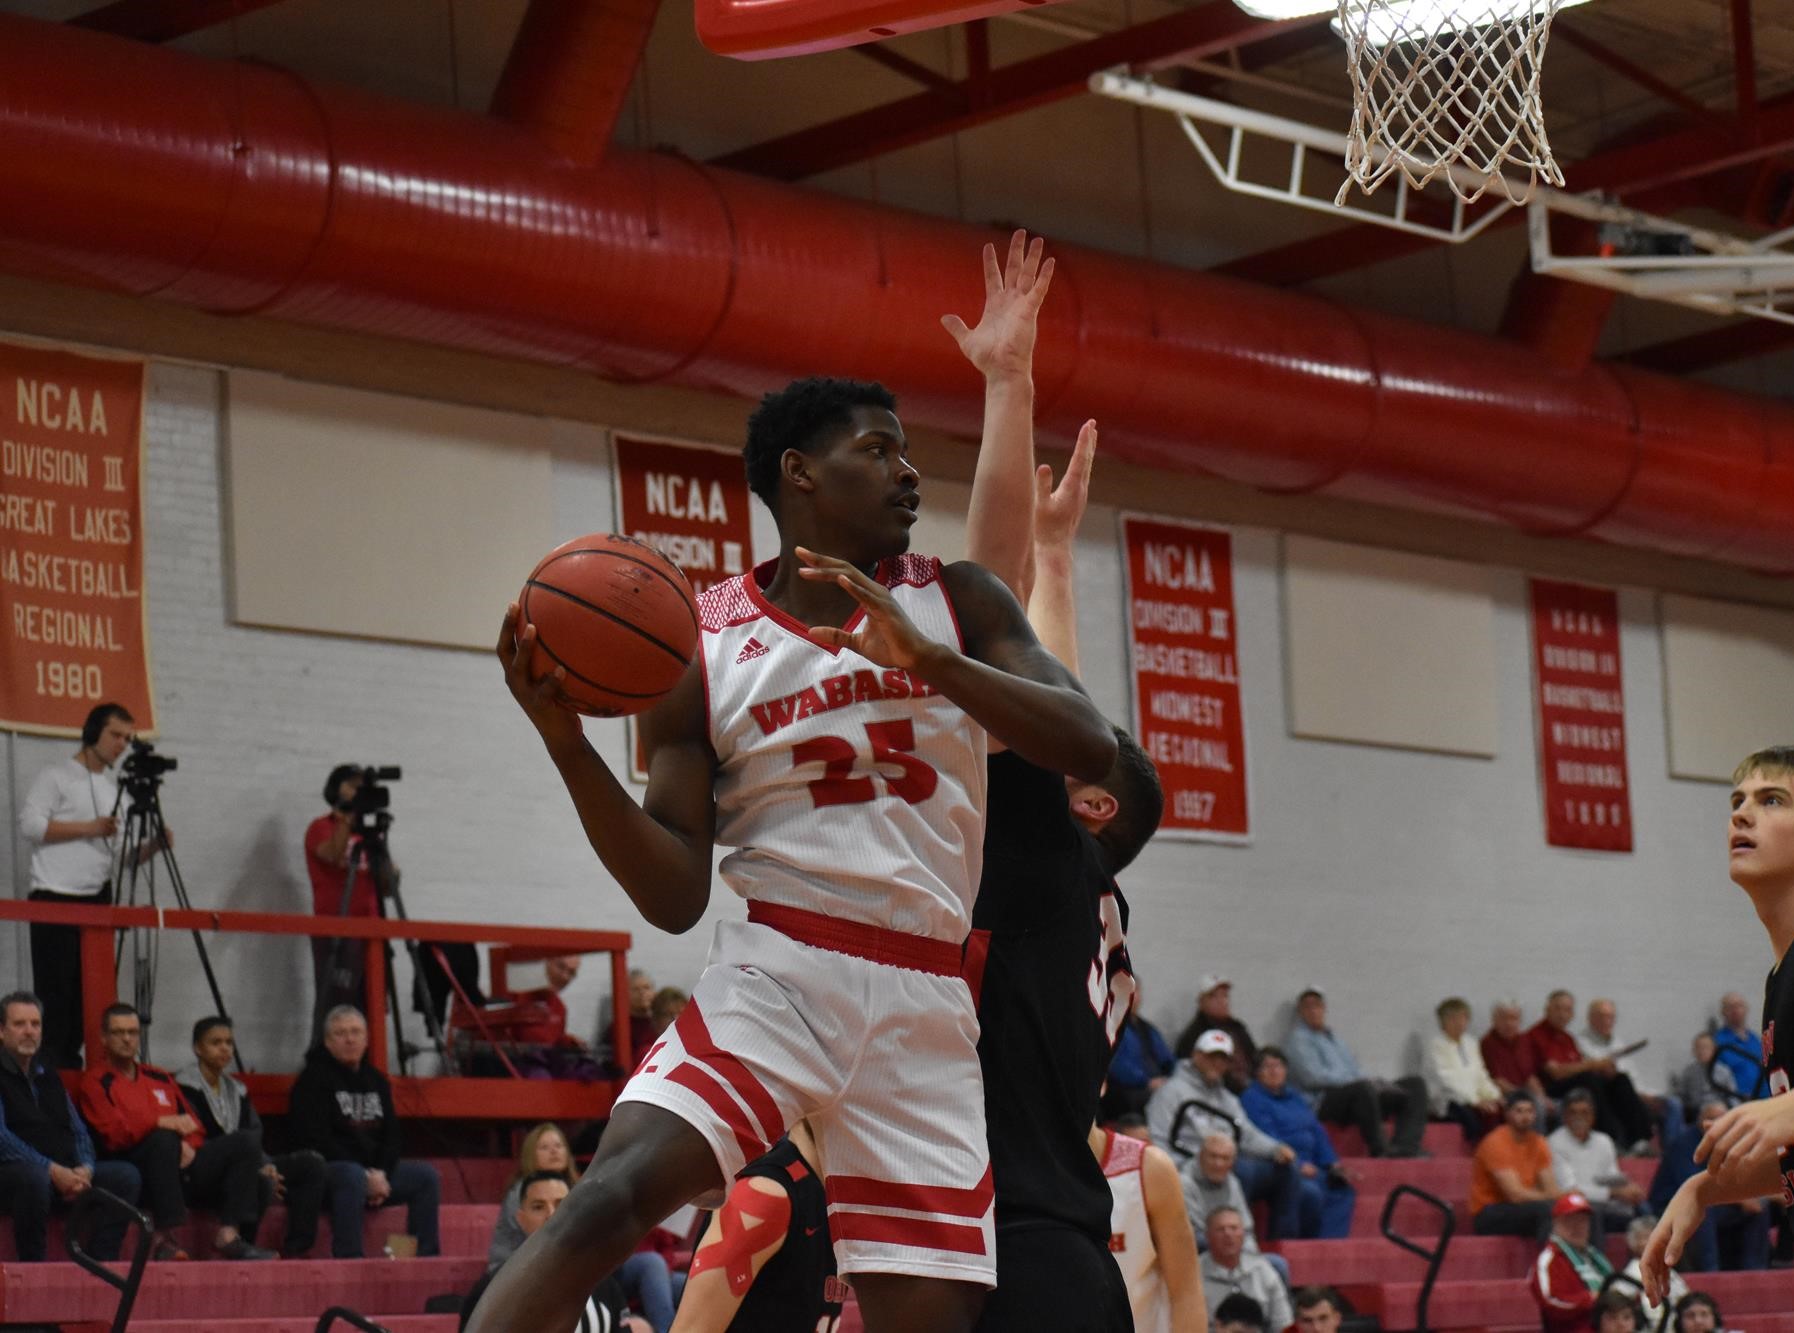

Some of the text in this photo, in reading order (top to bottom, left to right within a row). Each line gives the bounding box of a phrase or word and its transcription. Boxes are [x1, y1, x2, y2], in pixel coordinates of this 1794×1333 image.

[16, 377, 108, 436] NCAA
[3, 440, 125, 492] DIVISION III
[645, 472, 728, 524] NCAA
[70, 504, 132, 545] LAKES
[1144, 541, 1216, 594] NCAA
[14, 602, 124, 652] REGIONAL
[35, 661, 103, 698] 1980
[735, 645, 771, 665] adidas
[792, 716, 938, 809] 25
